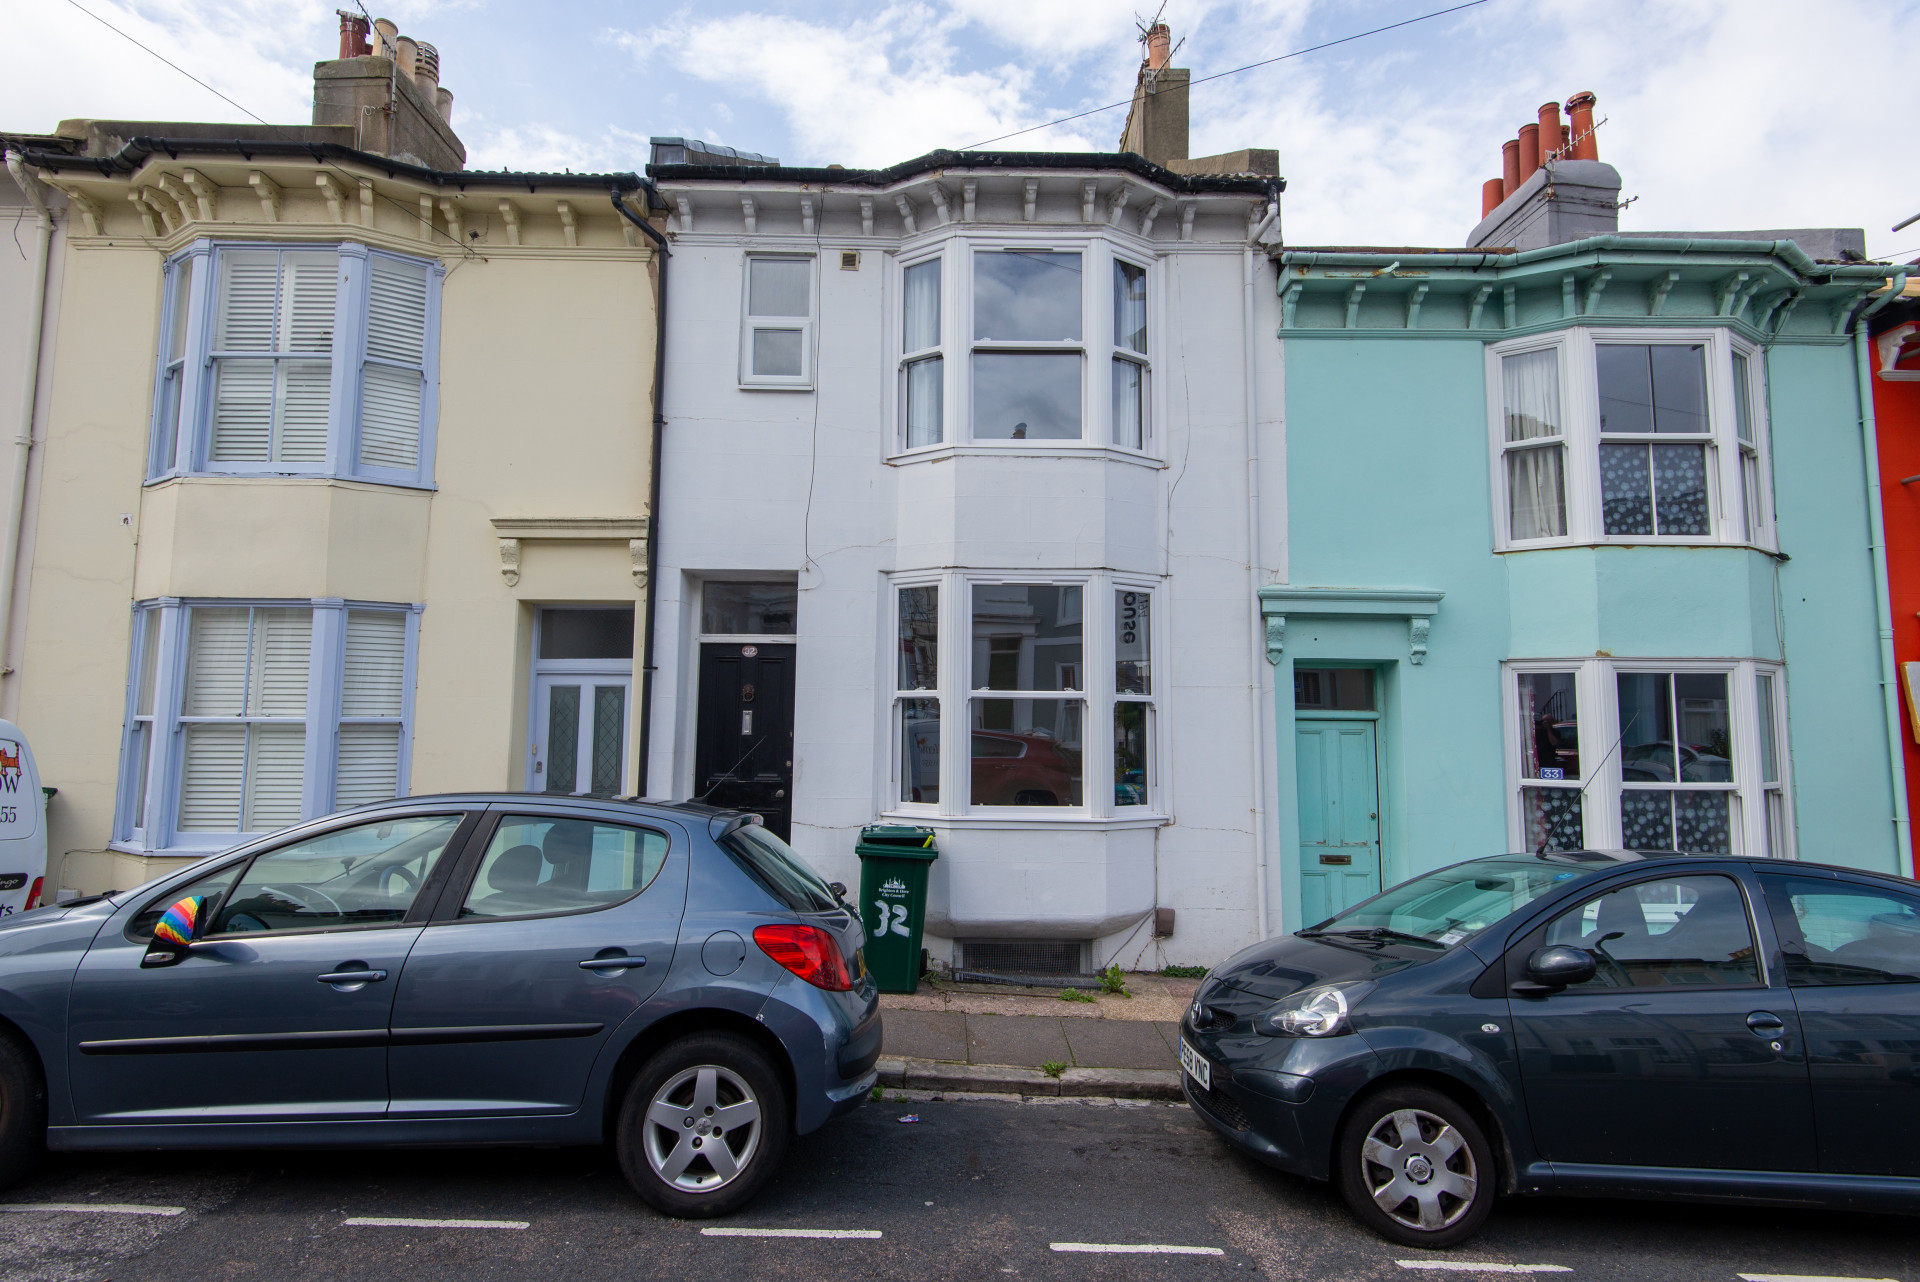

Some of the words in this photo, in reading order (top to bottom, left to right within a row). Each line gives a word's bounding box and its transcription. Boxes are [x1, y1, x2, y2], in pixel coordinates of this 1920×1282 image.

[744, 647, 756, 656] 32
[1544, 769, 1559, 778] 33
[873, 900, 910, 938] 32
